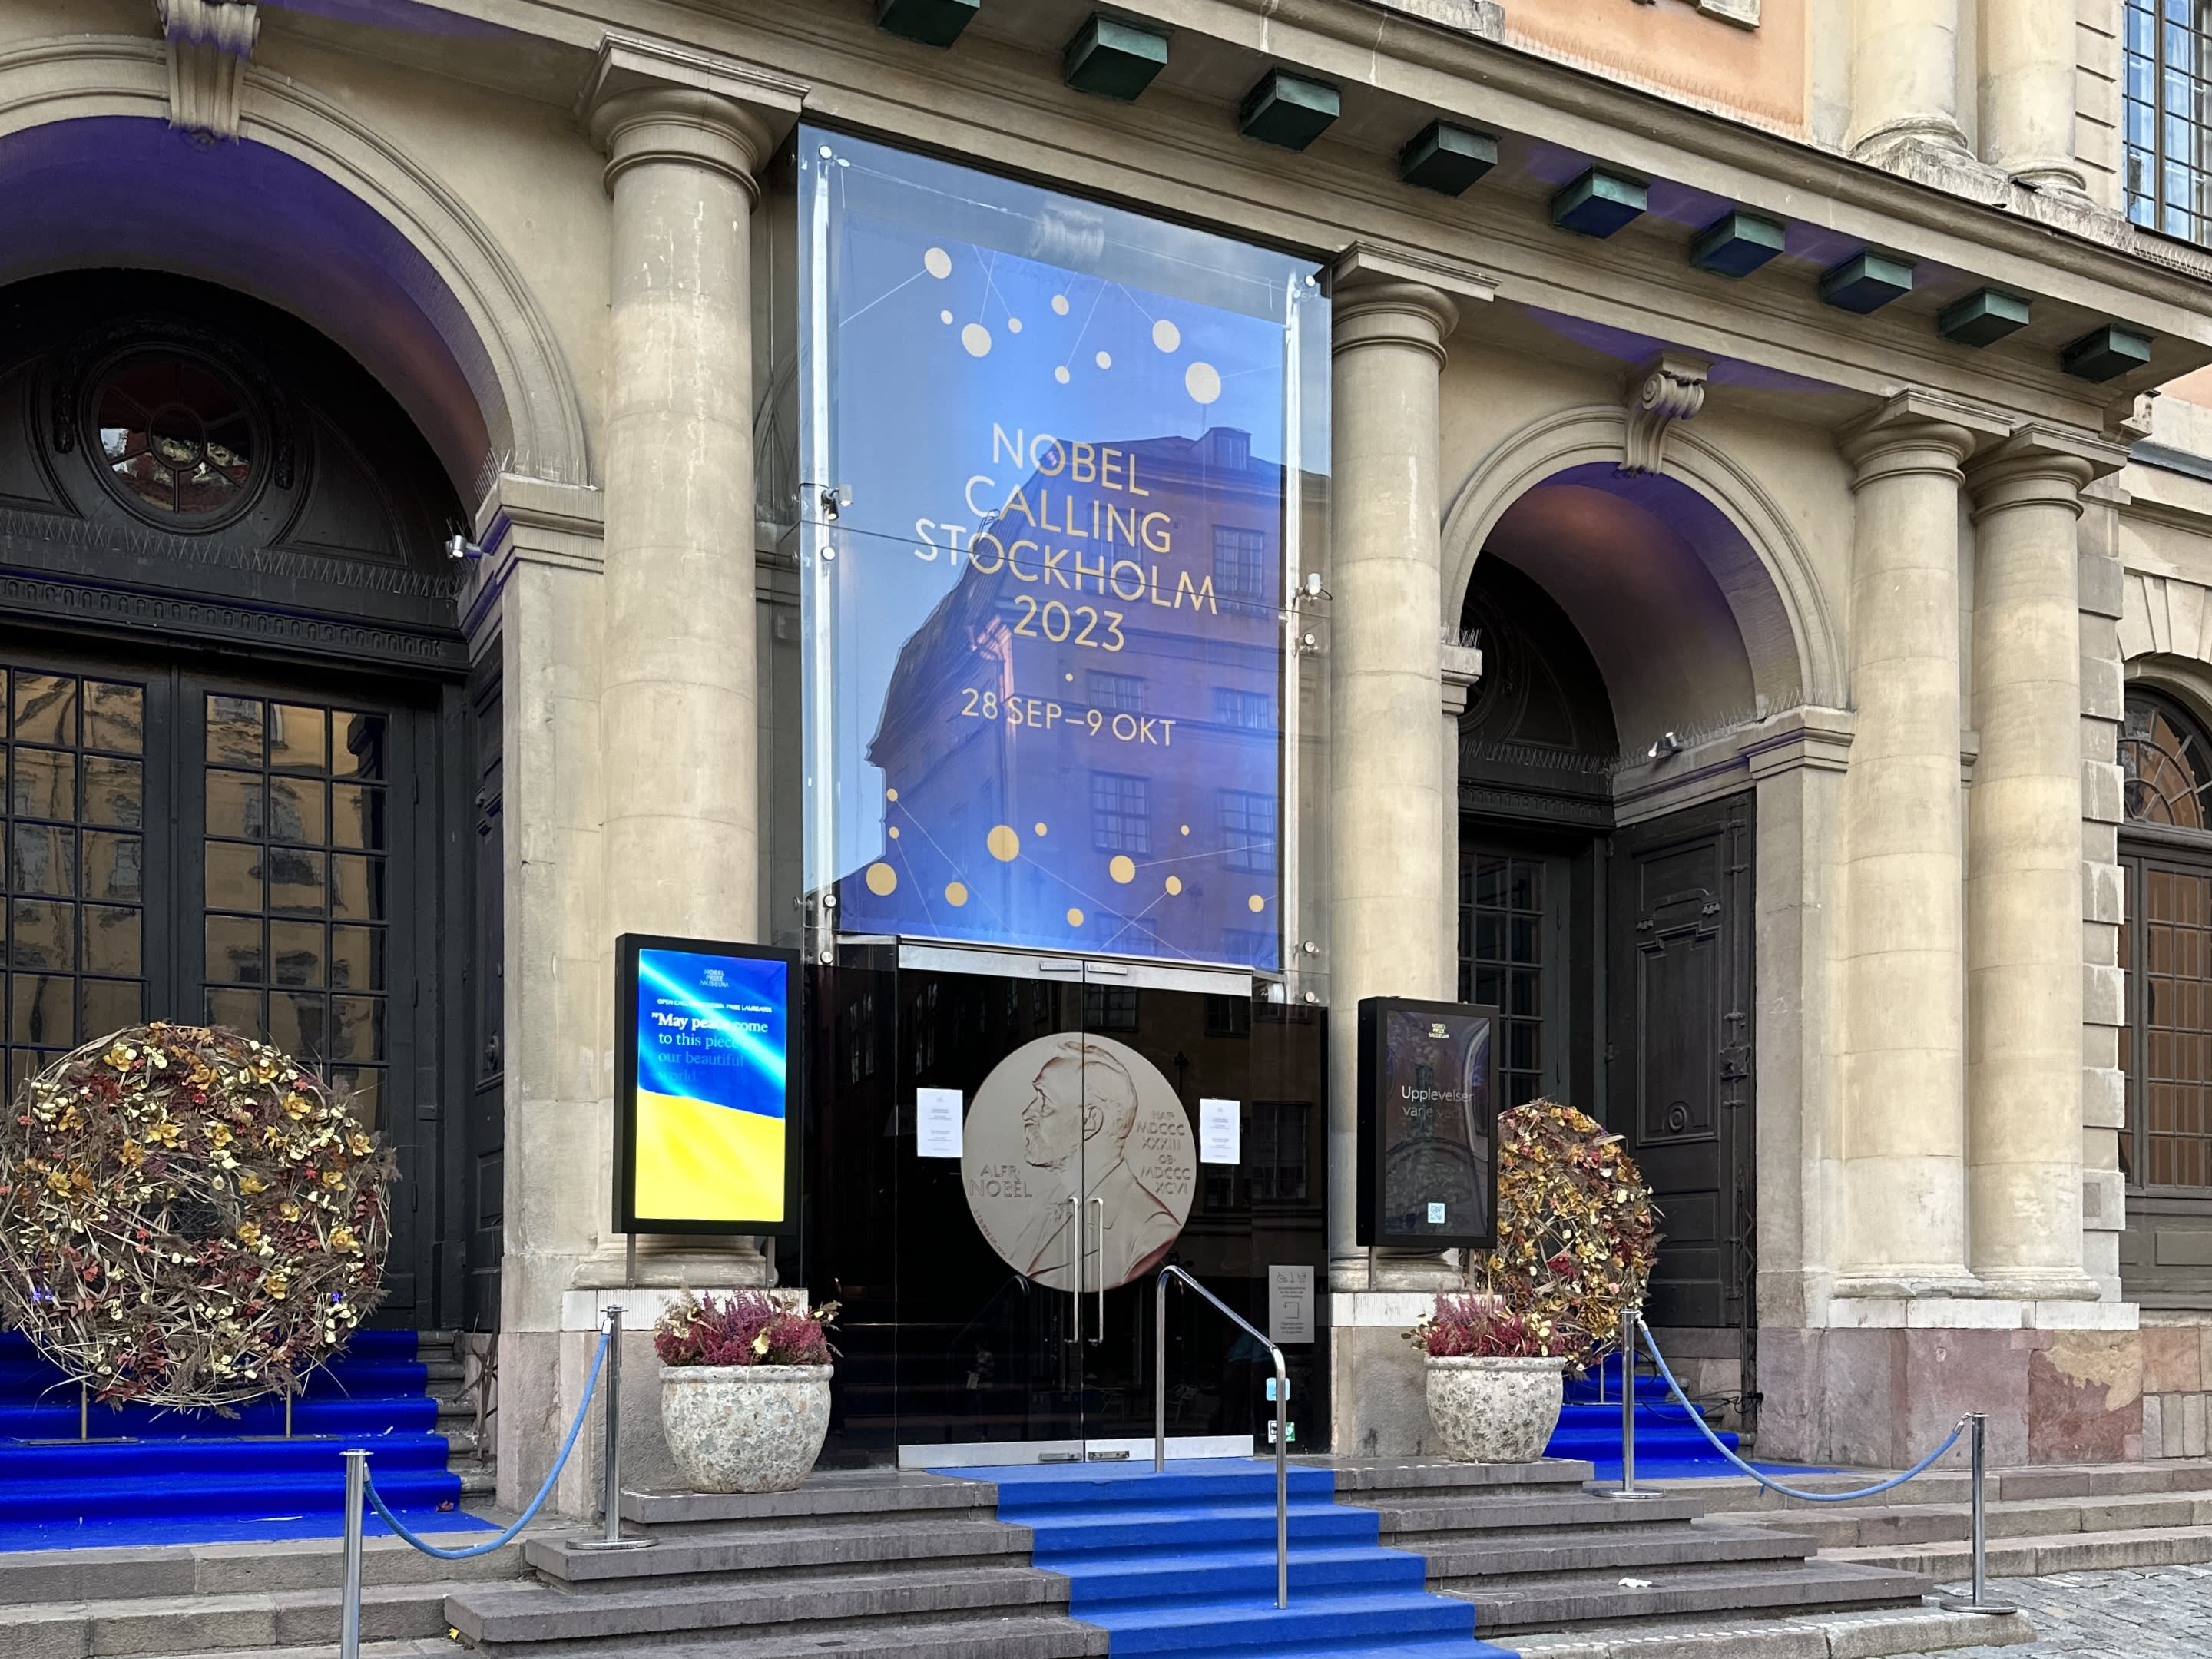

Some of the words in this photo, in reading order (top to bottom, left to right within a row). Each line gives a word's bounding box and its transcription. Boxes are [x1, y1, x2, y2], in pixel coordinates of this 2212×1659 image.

[992, 422, 1150, 497] NOBEL
[965, 475, 1171, 553] CALLING
[914, 518, 1217, 615] STOCKHOLM
[1013, 594, 1125, 652] 2023
[961, 687, 998, 720] 28
[1112, 713, 1177, 747] OKT
[658, 1032, 673, 1045] to
[676, 1032, 701, 1046] this
[658, 1051, 682, 1064] our
[685, 1051, 743, 1067] beautiful
[1402, 1085, 1475, 1103] Upplevelser
[1402, 1105, 1433, 1120] varje
[1137, 1121, 1185, 1136] MDCCC
[969, 1179, 1033, 1198] NOBEL
